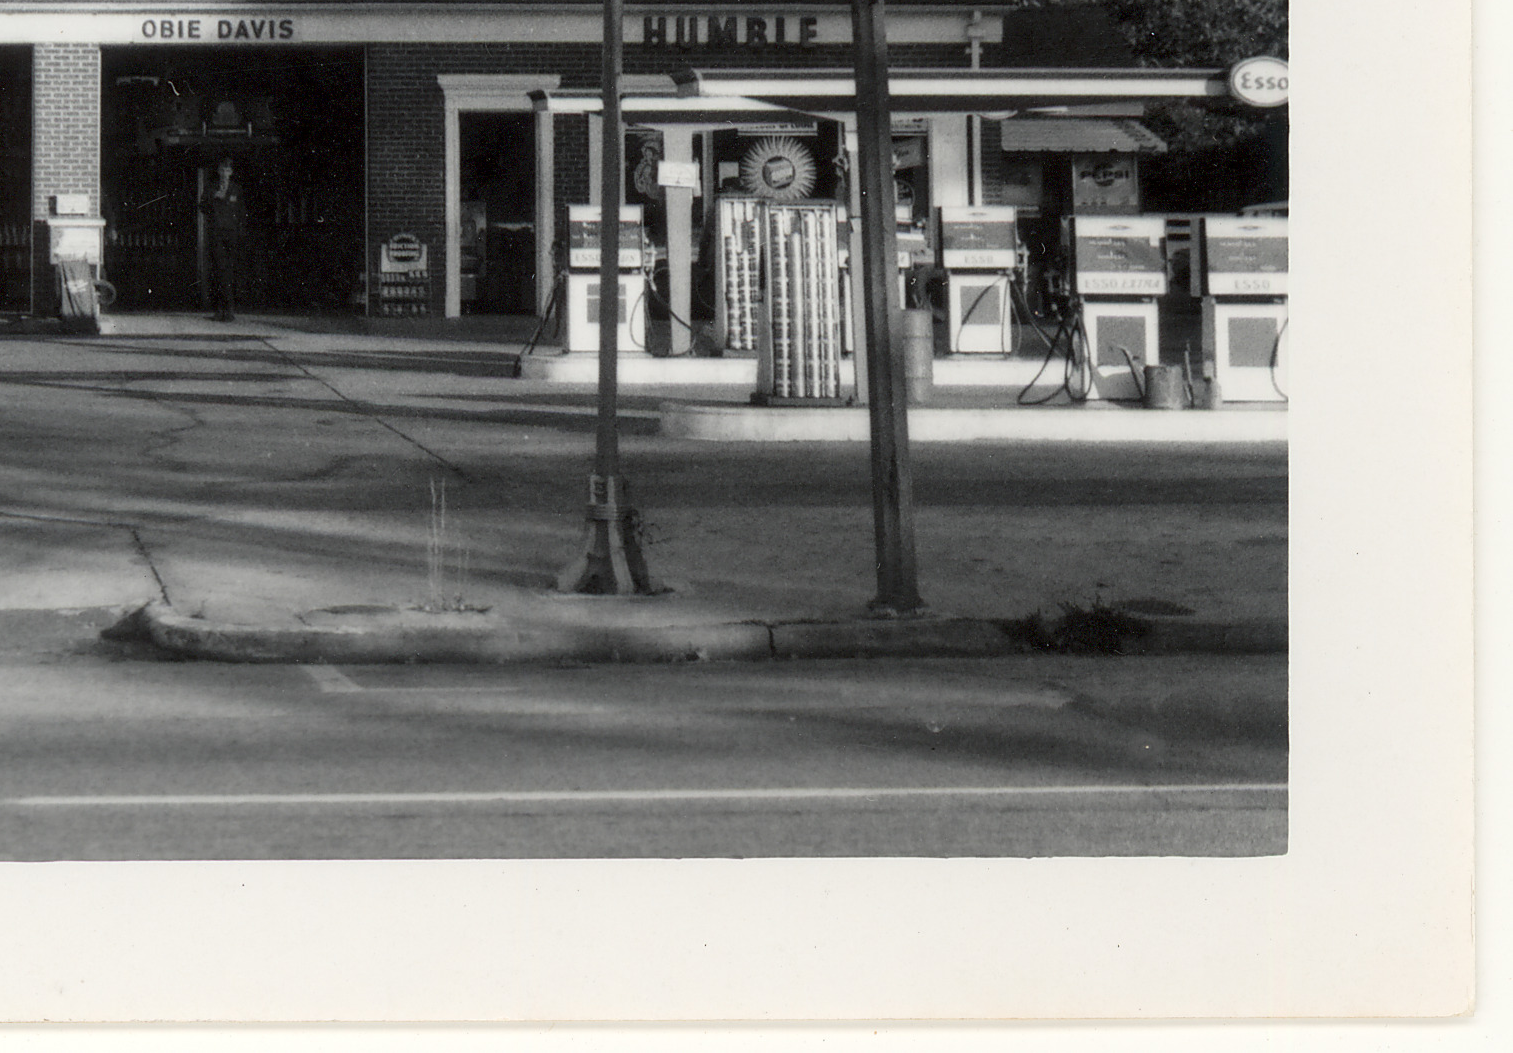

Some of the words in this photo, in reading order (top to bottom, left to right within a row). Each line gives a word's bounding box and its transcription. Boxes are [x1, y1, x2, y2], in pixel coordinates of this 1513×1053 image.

[141, 19, 201, 39] OBIE
[217, 19, 294, 39] DAVIS
[1241, 71, 1289, 90] Esso
